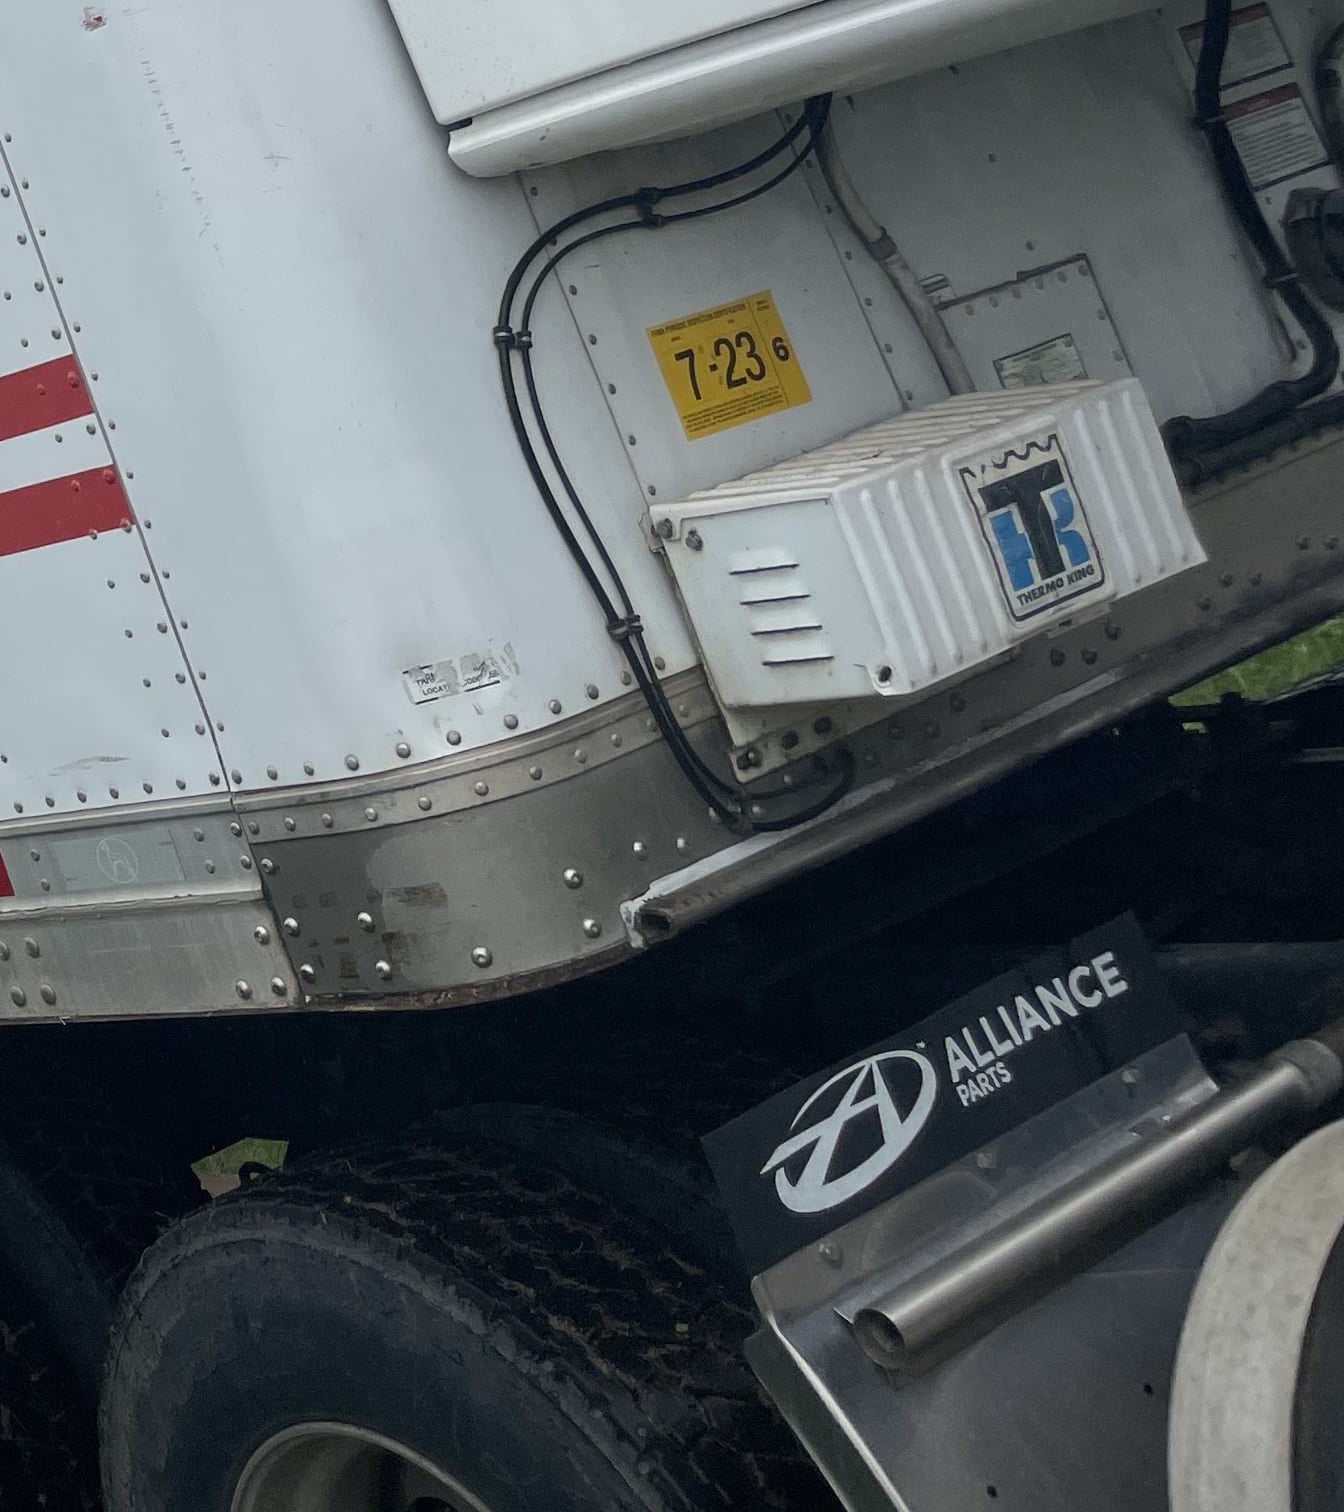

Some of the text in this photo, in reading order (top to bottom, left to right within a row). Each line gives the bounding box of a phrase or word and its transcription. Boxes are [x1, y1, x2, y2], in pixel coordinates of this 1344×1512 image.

[1015, 563, 1095, 606] THERMO KING
[944, 950, 1129, 1084] ALLIANCE
[955, 1061, 1012, 1107] PARTS
